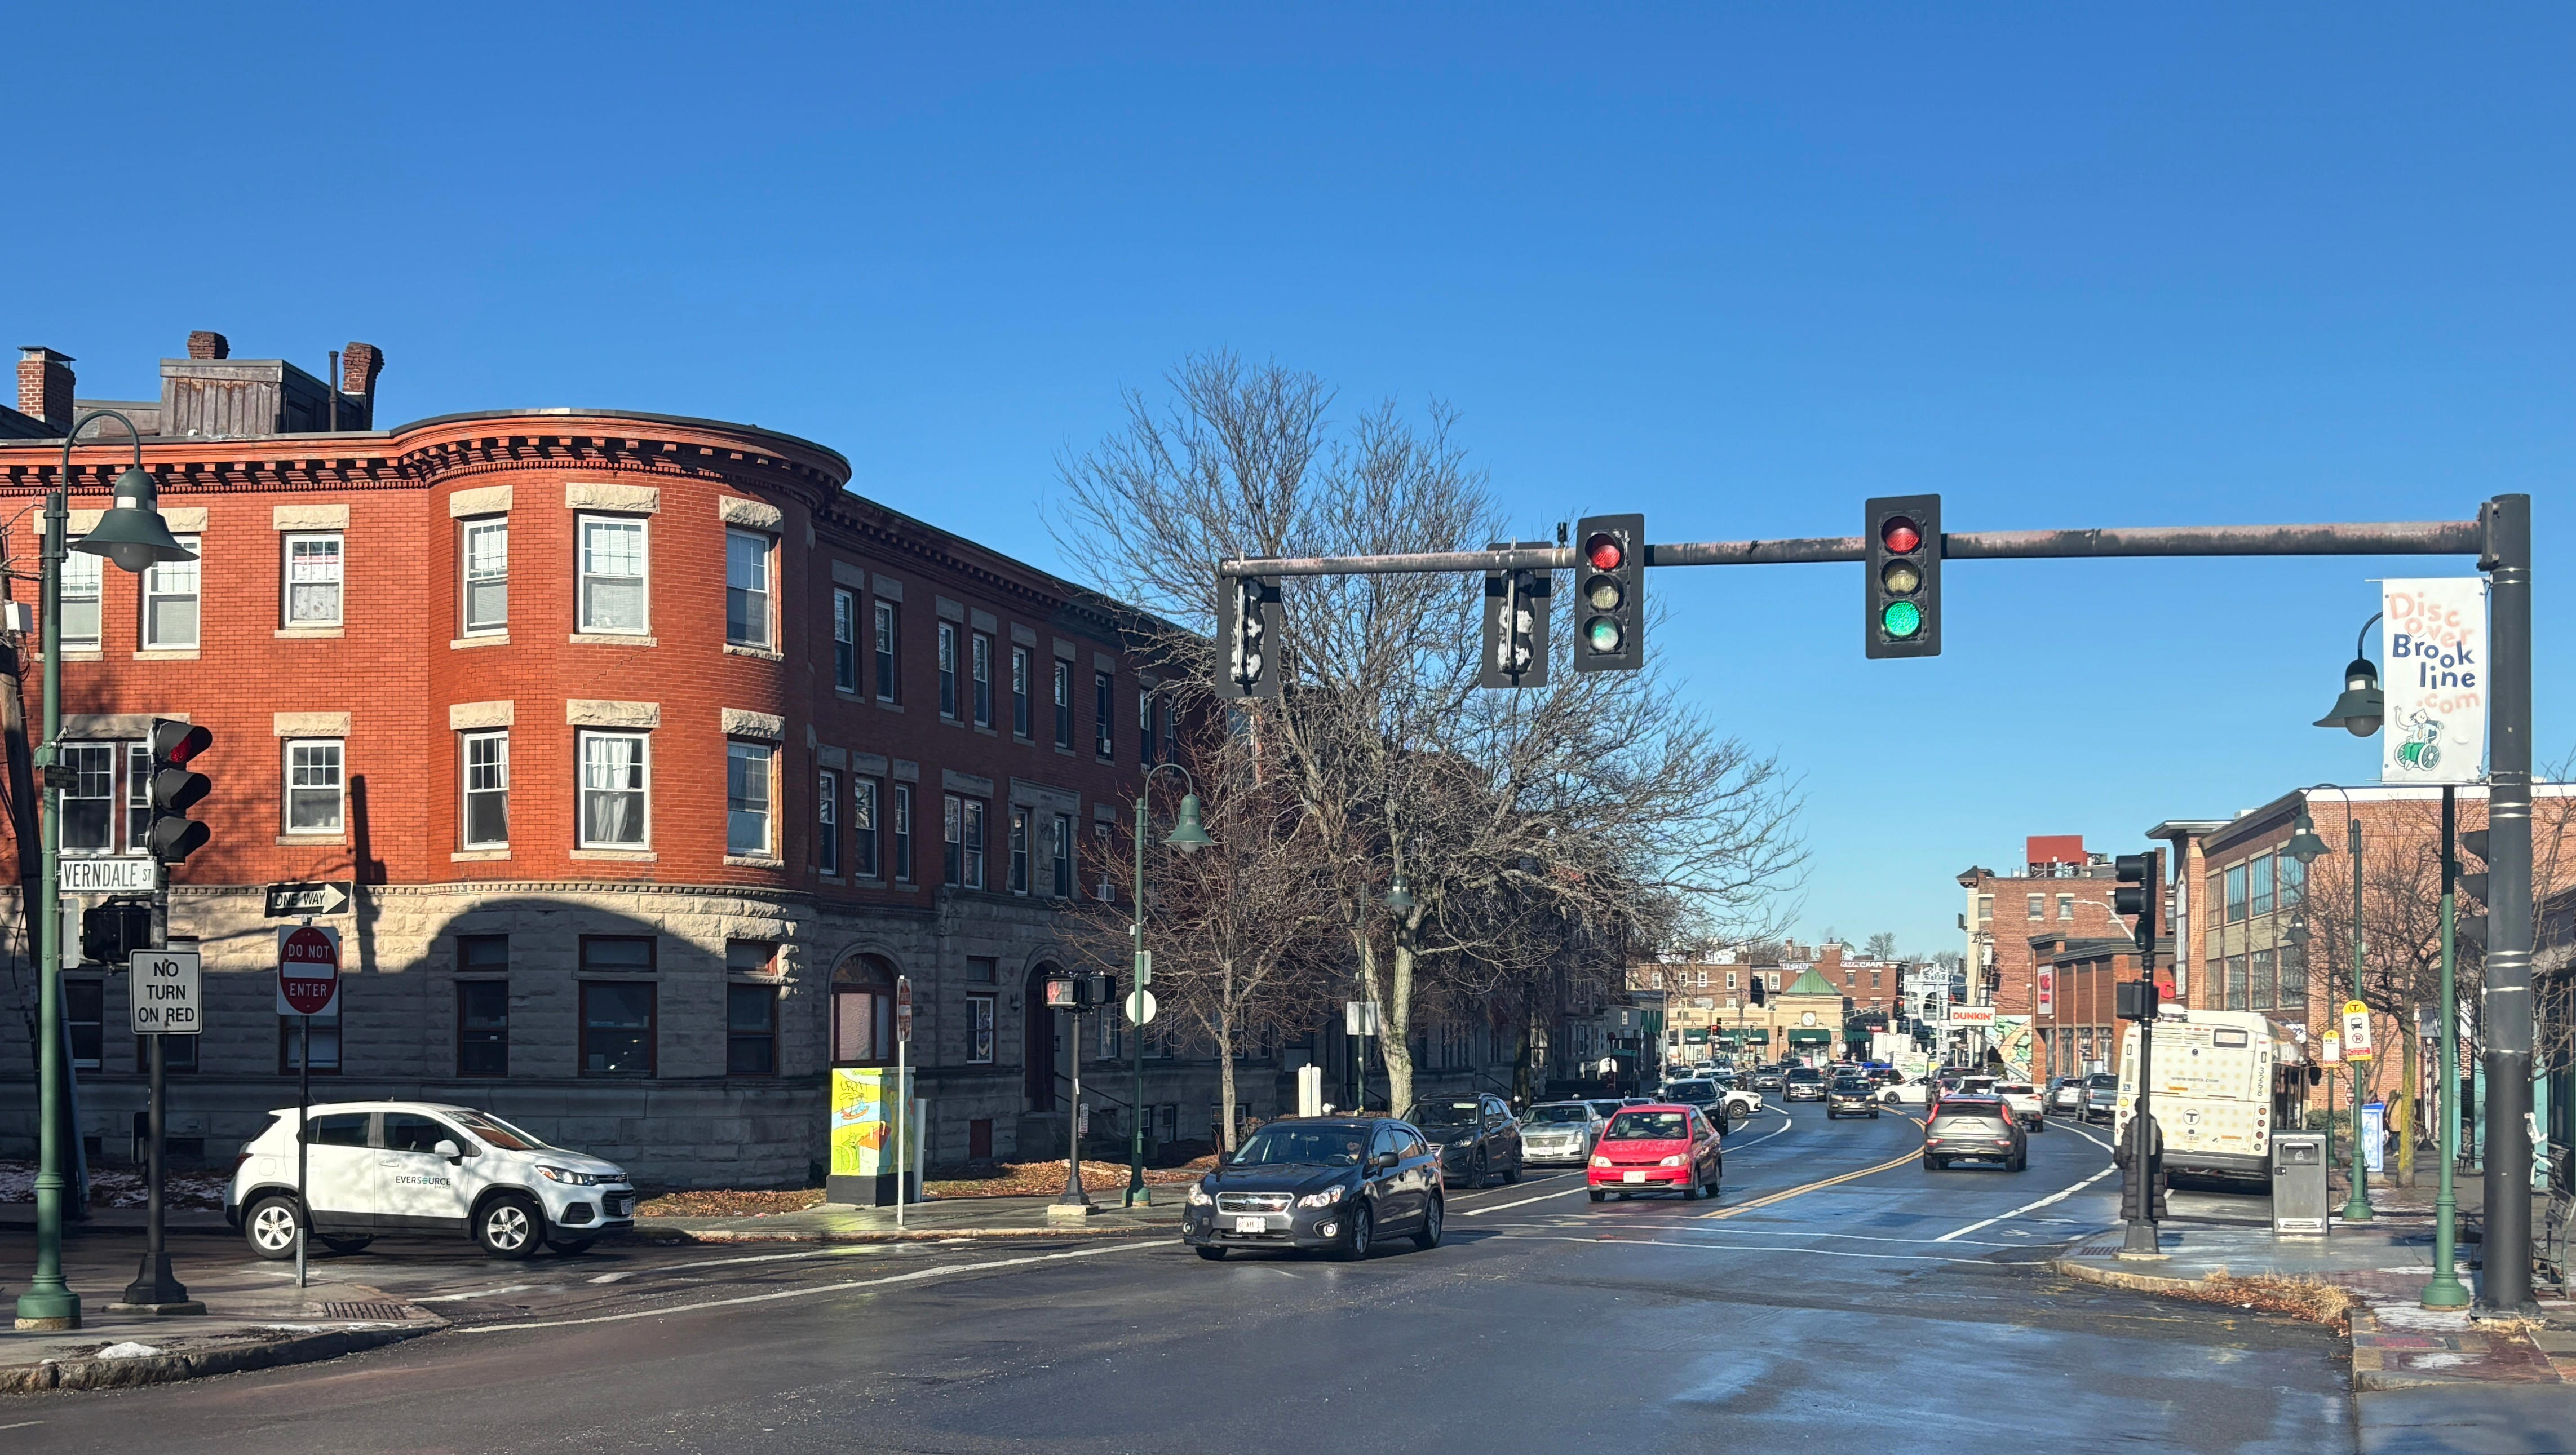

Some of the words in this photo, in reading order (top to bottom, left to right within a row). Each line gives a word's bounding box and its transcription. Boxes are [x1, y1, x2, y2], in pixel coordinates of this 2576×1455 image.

[2389, 592, 2460, 627] Disc
[2404, 618, 2473, 648] over
[2393, 633, 2475, 669] Brook
[2420, 661, 2476, 689] line
[2416, 692, 2480, 714] .com
[64, 863, 138, 887] VERNDALE
[142, 869, 152, 882] ST
[275, 893, 299, 906] ONE
[303, 892, 326, 905] WAY
[289, 944, 303, 957] DO
[308, 945, 330, 958] NOT
[154, 962, 179, 977] NO
[146, 984, 185, 1000] TURN
[290, 983, 327, 997] ENTER
[139, 1007, 158, 1023] ON
[166, 1007, 194, 1022] RED
[1953, 1012, 1993, 1020] DUNKIN'
[396, 1176, 451, 1186] EVERSOURCE
